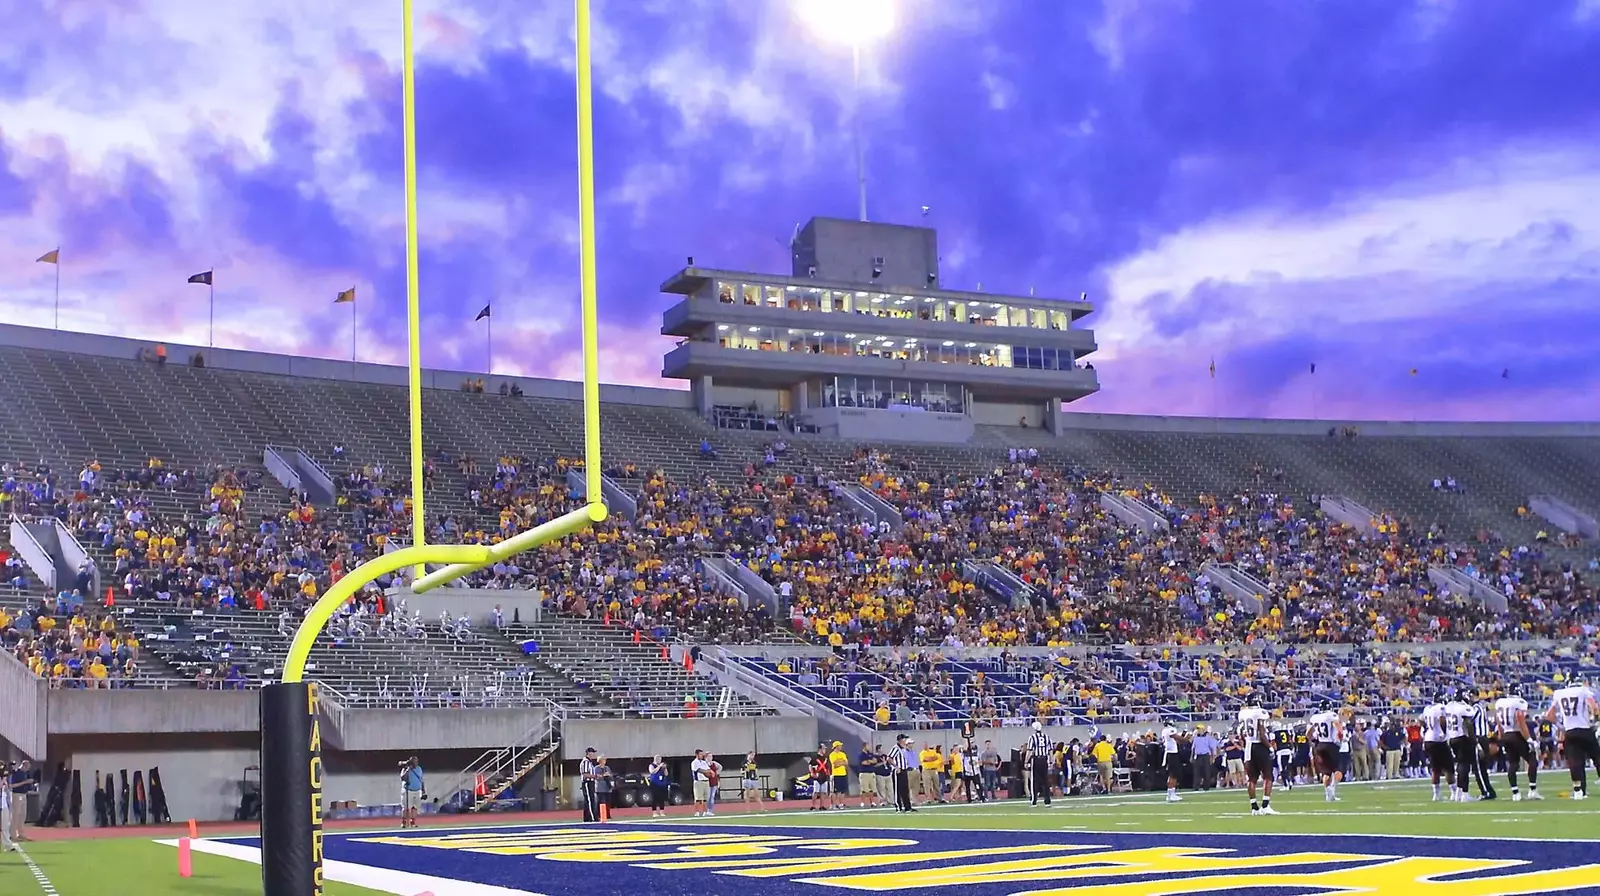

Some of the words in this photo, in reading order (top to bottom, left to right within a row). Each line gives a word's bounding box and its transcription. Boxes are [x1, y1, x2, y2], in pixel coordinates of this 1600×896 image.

[1561, 697, 1578, 717] 97
[1039, 737, 1046, 747] R
[1280, 732, 1288, 743] 3
[308, 682, 323, 896] RACERS
